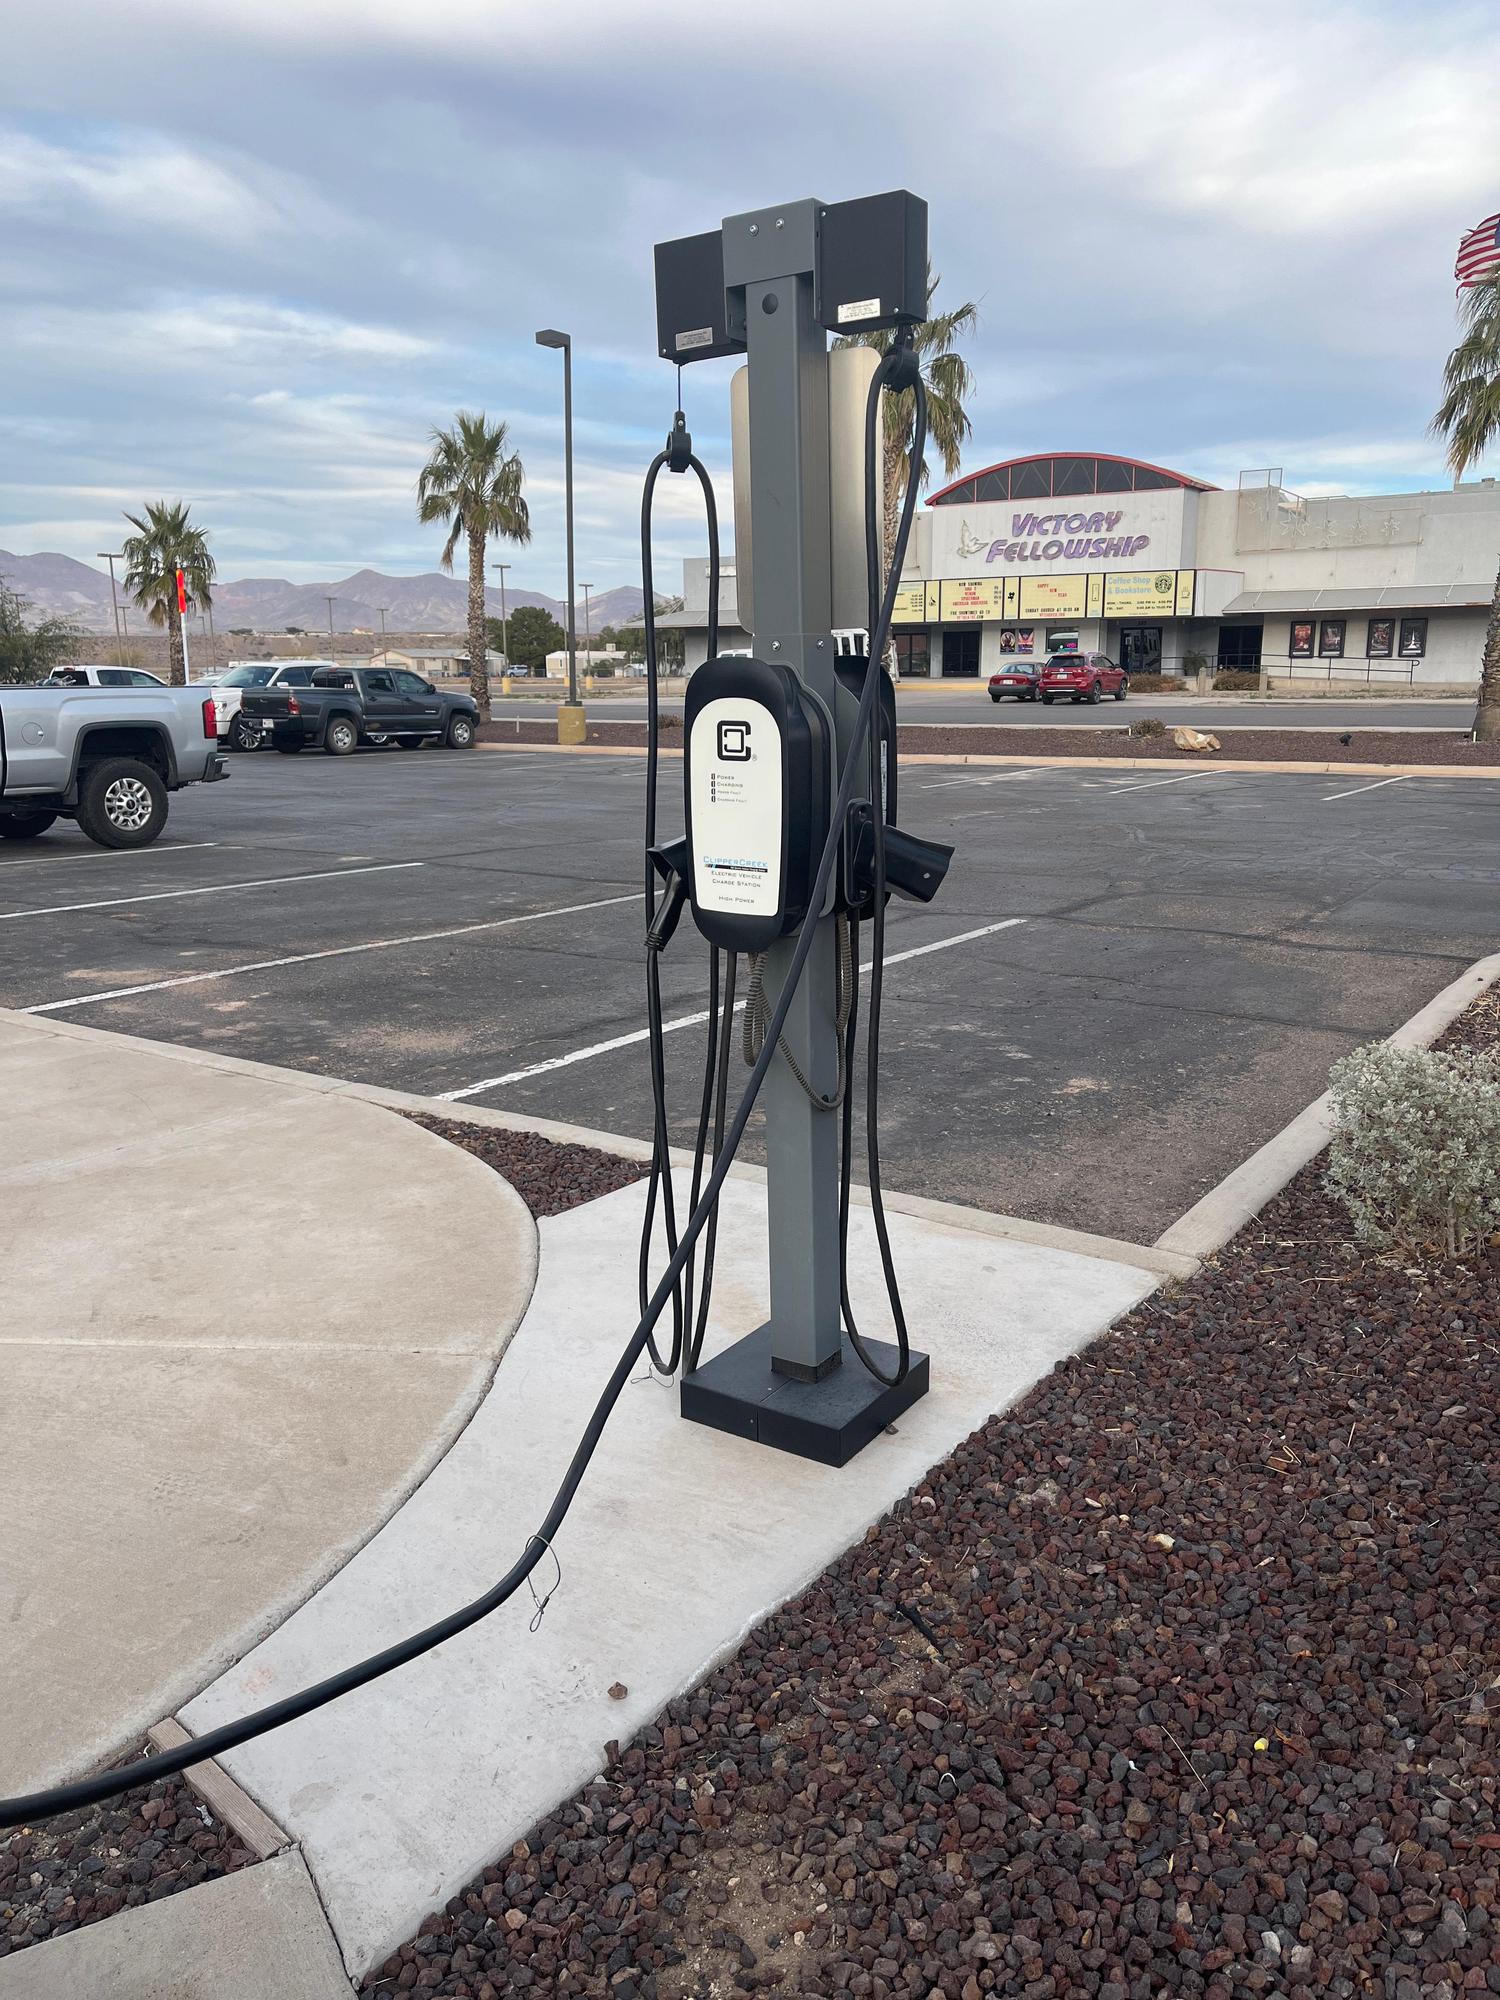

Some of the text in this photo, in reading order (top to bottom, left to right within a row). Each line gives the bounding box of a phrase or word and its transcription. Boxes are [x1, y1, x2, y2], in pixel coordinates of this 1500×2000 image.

[1011, 510, 1124, 538] VICTORY
[985, 534, 1151, 563] FELLOWSHIP
[1108, 576, 1130, 585] Coffee
[1132, 576, 1151, 585] Shop
[1115, 586, 1152, 594] Bookstore
